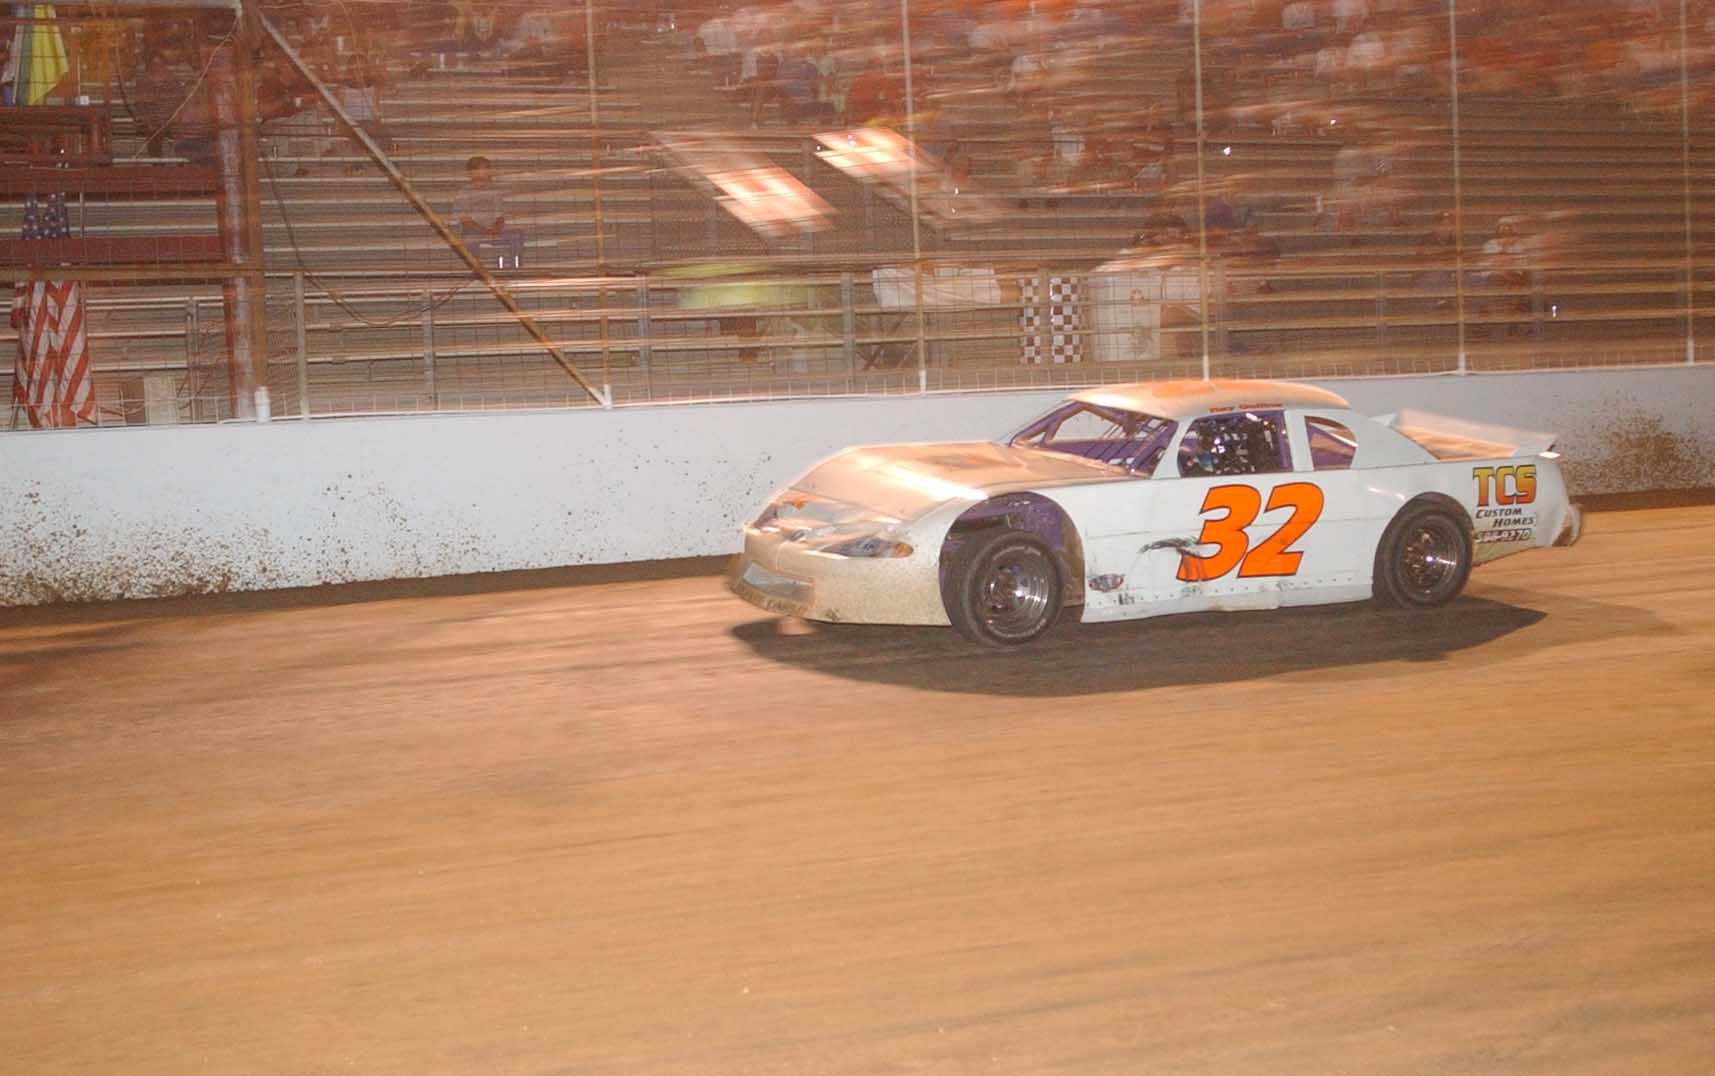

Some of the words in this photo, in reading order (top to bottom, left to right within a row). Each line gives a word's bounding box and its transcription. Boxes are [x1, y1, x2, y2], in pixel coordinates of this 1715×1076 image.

[1473, 464, 1537, 507] TCS
[1176, 482, 1324, 582] 32
[1494, 517, 1534, 528] HOMES
